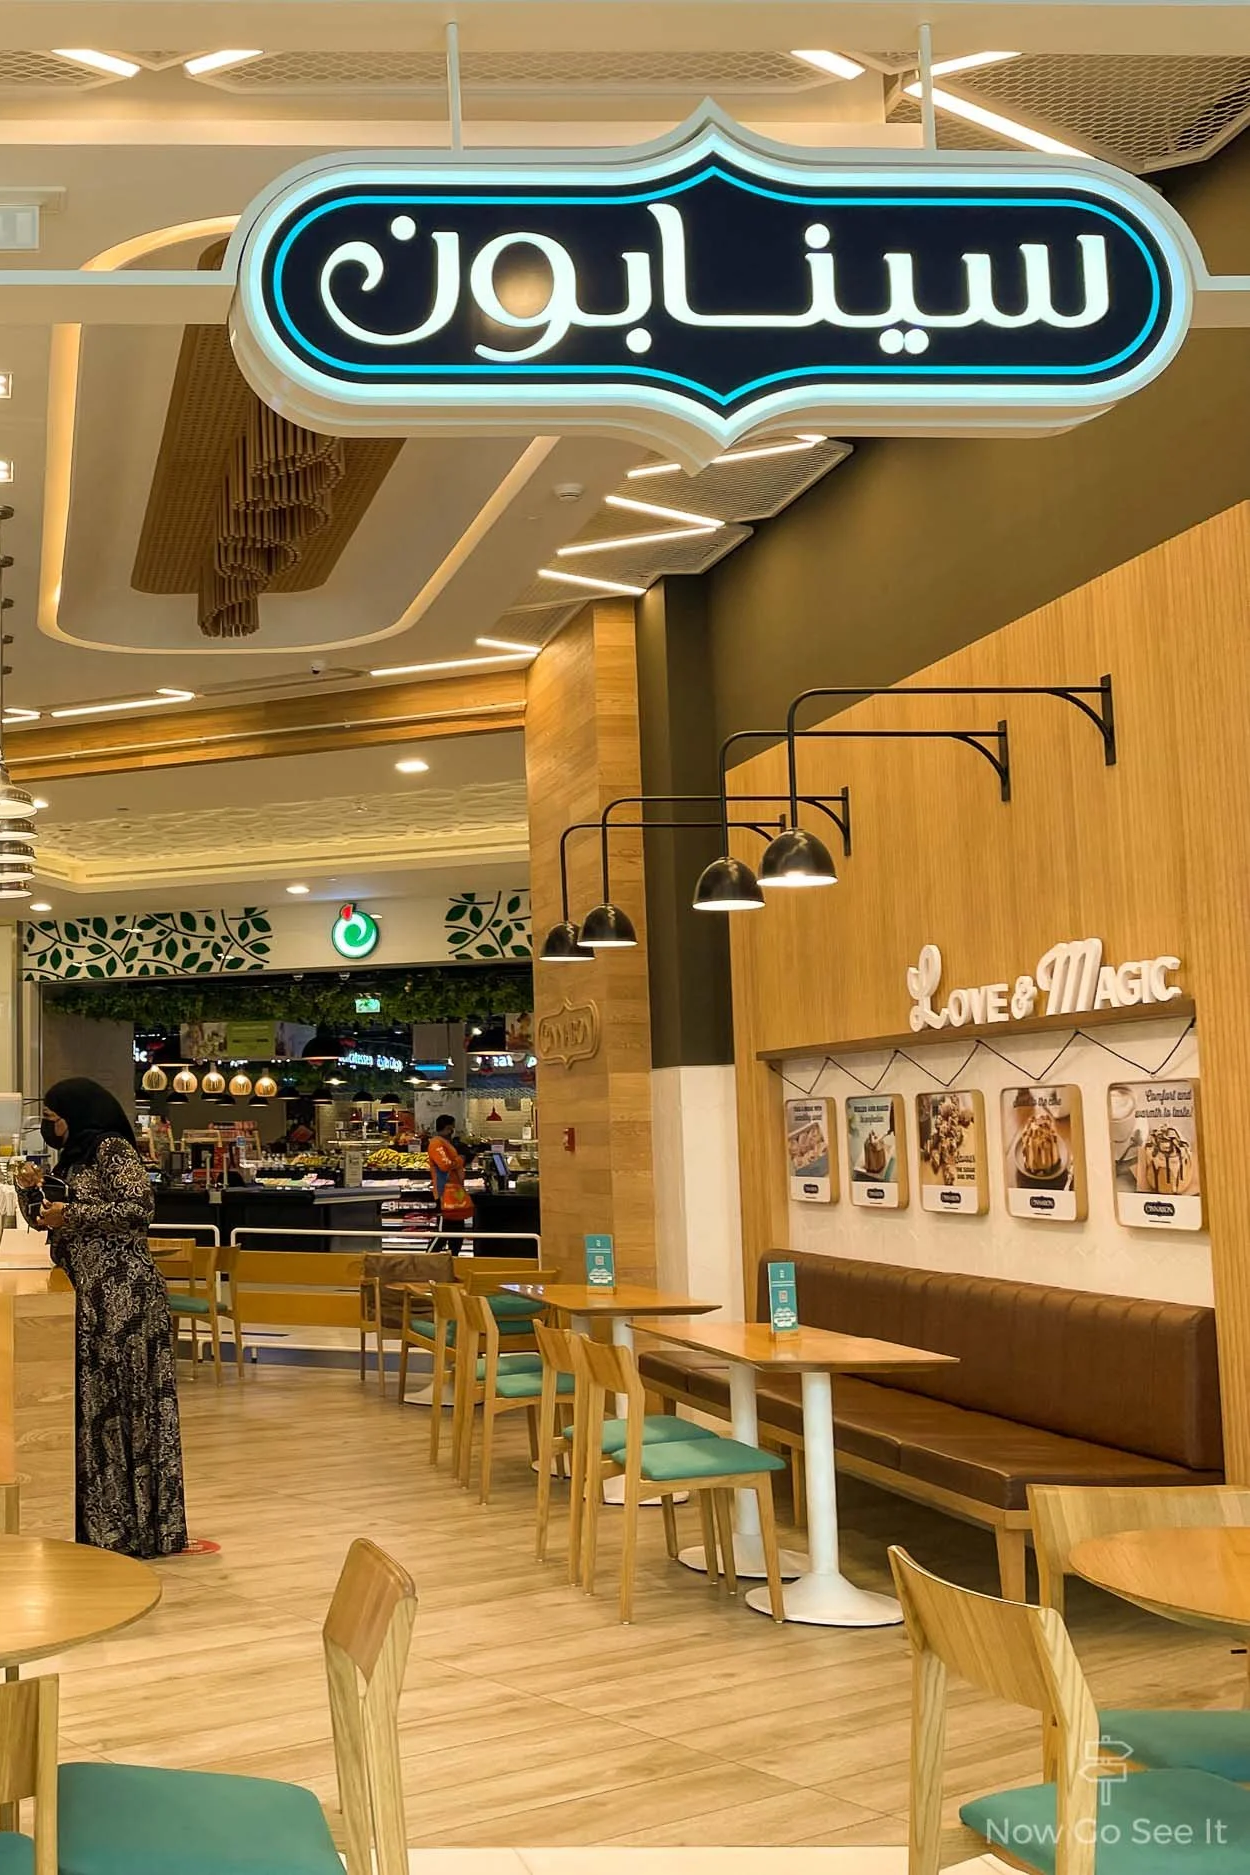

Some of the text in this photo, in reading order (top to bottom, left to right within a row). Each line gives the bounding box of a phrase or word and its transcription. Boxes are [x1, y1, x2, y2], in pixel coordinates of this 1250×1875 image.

[319, 203, 1113, 364] سينابون
[1010, 975, 1038, 1021] &
[1036, 937, 1183, 1016] MAGIC
[1144, 1089, 1192, 1105] Comfort and
